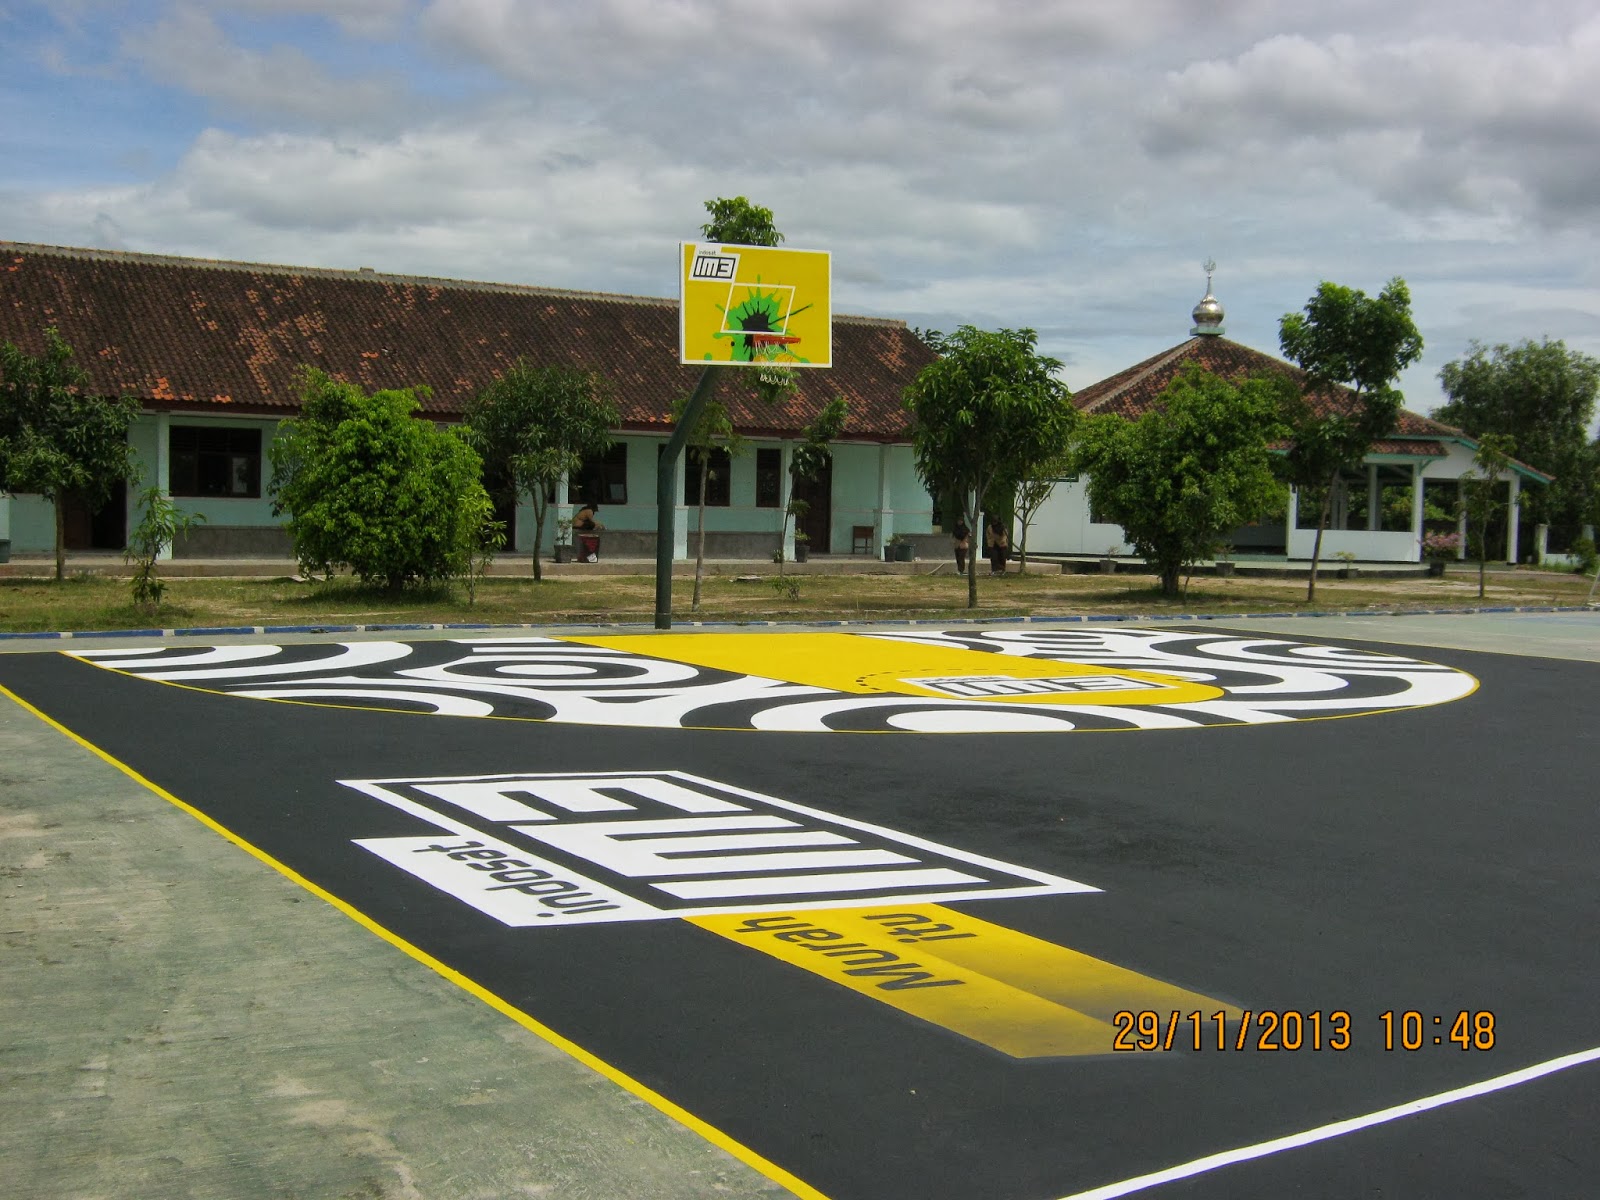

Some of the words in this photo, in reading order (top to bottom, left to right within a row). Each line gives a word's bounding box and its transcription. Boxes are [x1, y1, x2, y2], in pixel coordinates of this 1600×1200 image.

[694, 257, 735, 279] IM3
[412, 841, 621, 918] indosat
[735, 907, 966, 991] Murah
[862, 903, 978, 943] itu
